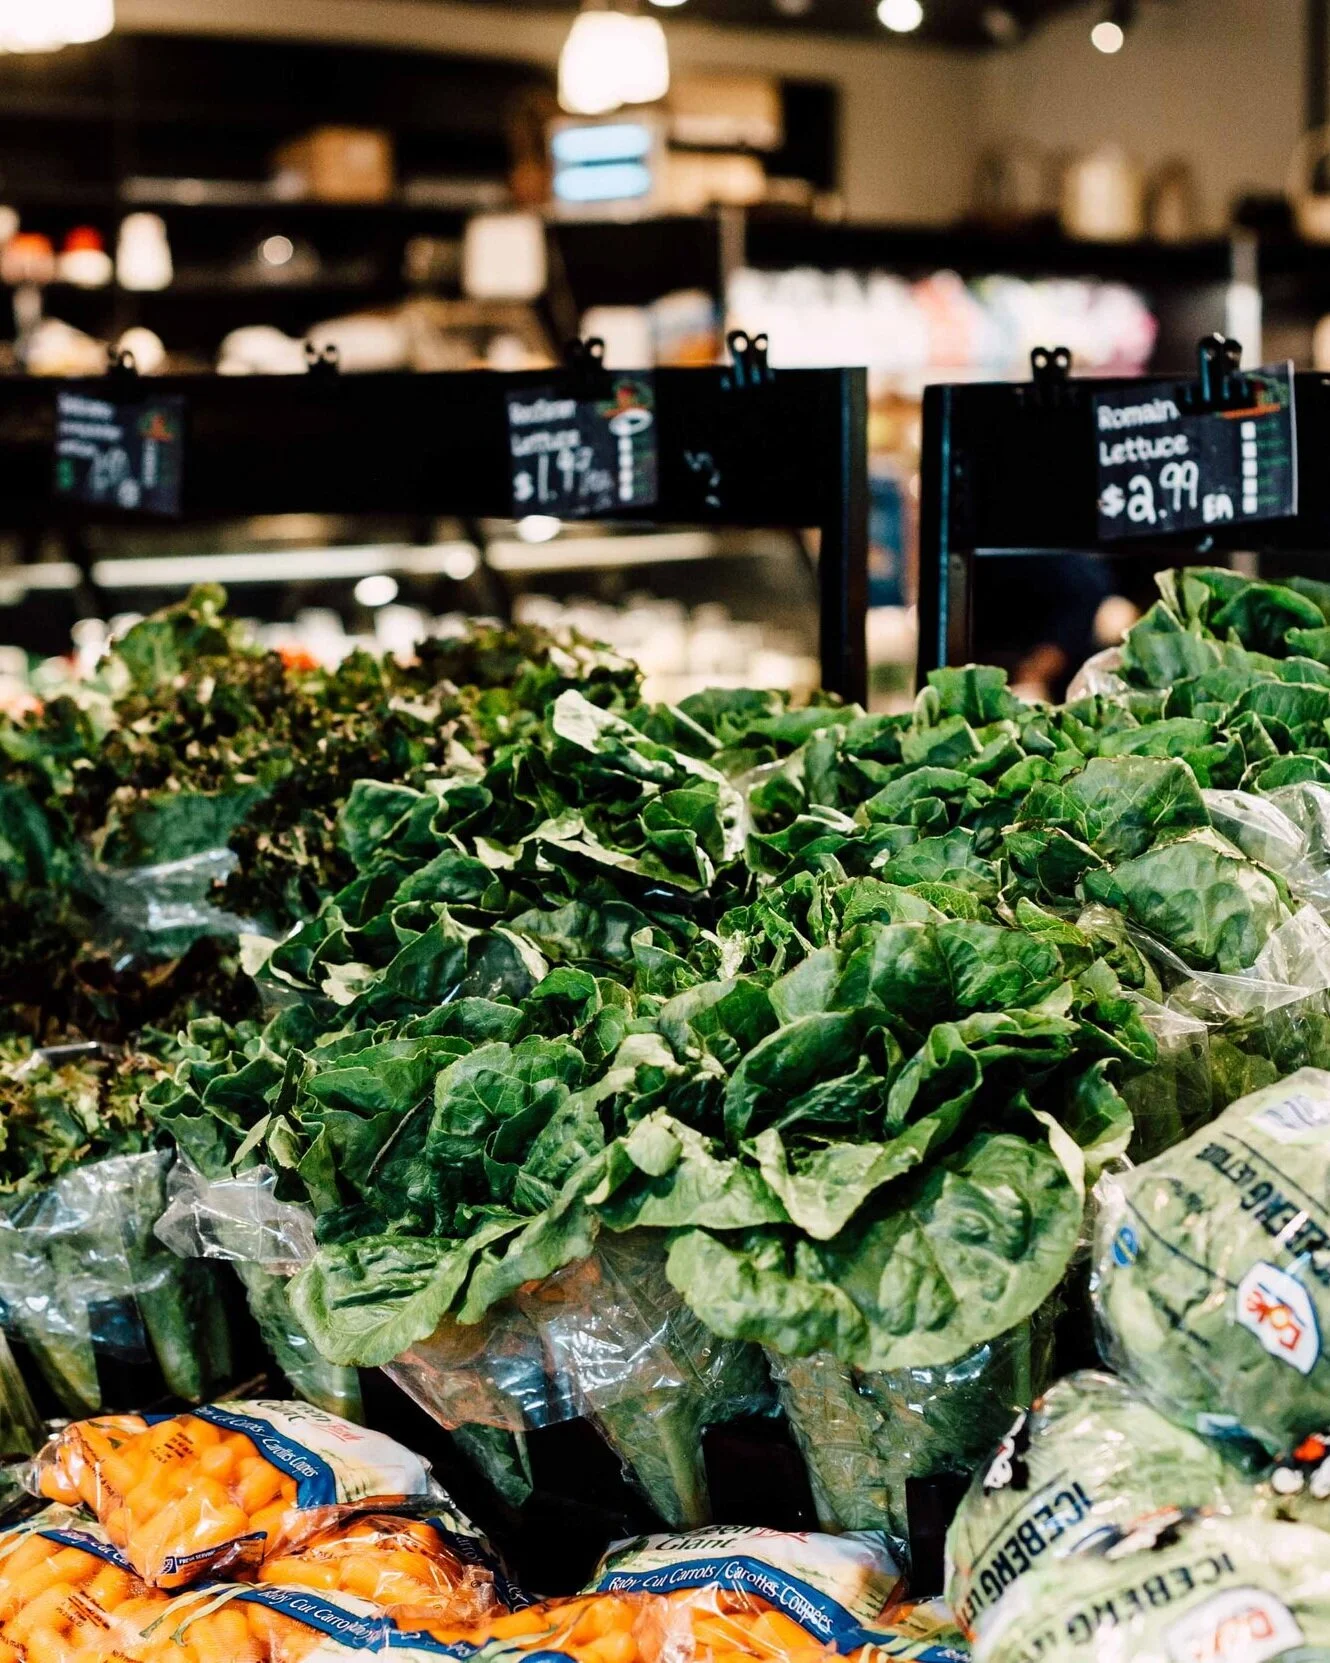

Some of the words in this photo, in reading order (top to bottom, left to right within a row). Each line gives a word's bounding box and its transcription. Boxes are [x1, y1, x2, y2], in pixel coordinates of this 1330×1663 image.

[1100, 434, 1190, 467] Lettuce
[1099, 459, 1199, 524] $2.99
[978, 1481, 1094, 1604] ICEBERG
[642, 1573, 669, 1588] Cut
[669, 1565, 716, 1584] Carrots
[725, 1561, 779, 1598] Carottes
[1066, 1552, 1239, 1646] ICEBERG
[289, 1598, 315, 1614] Cut
